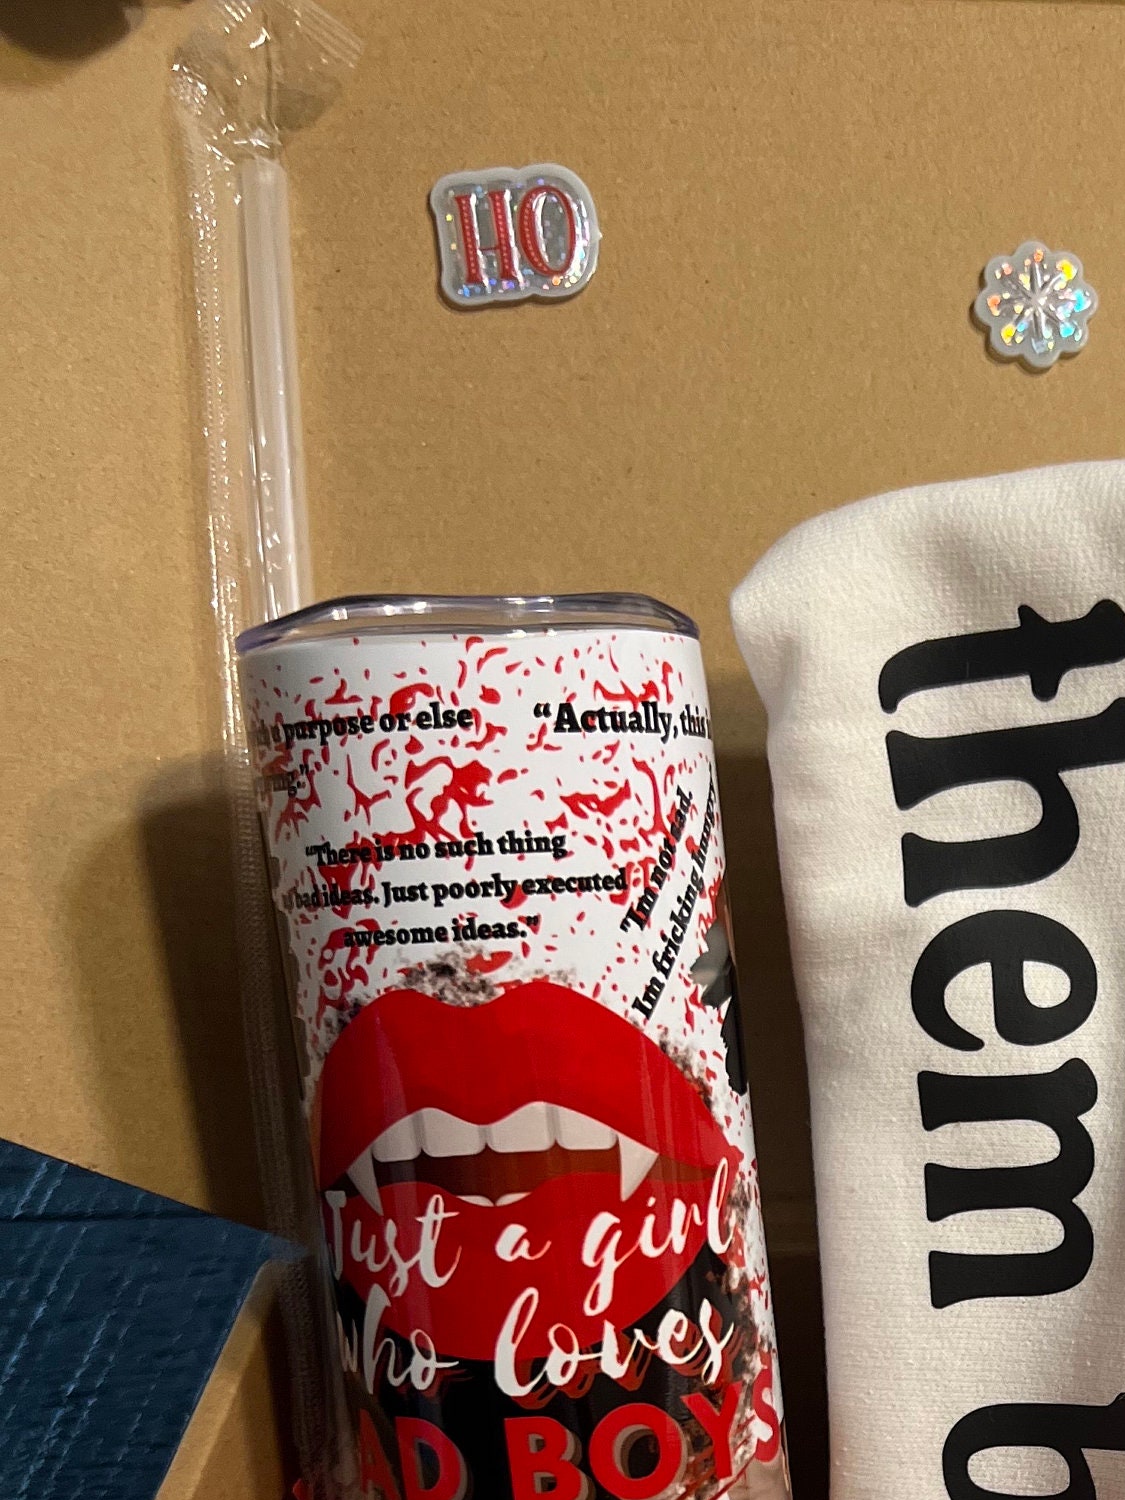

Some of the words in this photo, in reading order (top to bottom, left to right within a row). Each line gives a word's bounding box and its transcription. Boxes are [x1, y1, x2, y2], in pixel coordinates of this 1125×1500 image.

[455, 185, 577, 285] HO
[282, 714, 376, 750] purpose
[379, 711, 411, 733] or
[415, 701, 475, 732] else
[680, 703, 707, 738] this
[375, 838, 394, 863] is
[398, 840, 431, 861] no
[434, 832, 495, 859] such
[497, 830, 567, 859] thing
[650, 835, 678, 891] not
[380, 881, 430, 908] Just
[432, 872, 521, 906] poorly
[521, 867, 628, 896] executed
[343, 921, 448, 948] awesome
[632, 974, 666, 1021] Im
[652, 862, 706, 981] fricking
[325, 1190, 462, 1297] Just
[494, 1223, 552, 1262] a
[581, 1156, 738, 1317] girl
[493, 1287, 735, 1398] loves
